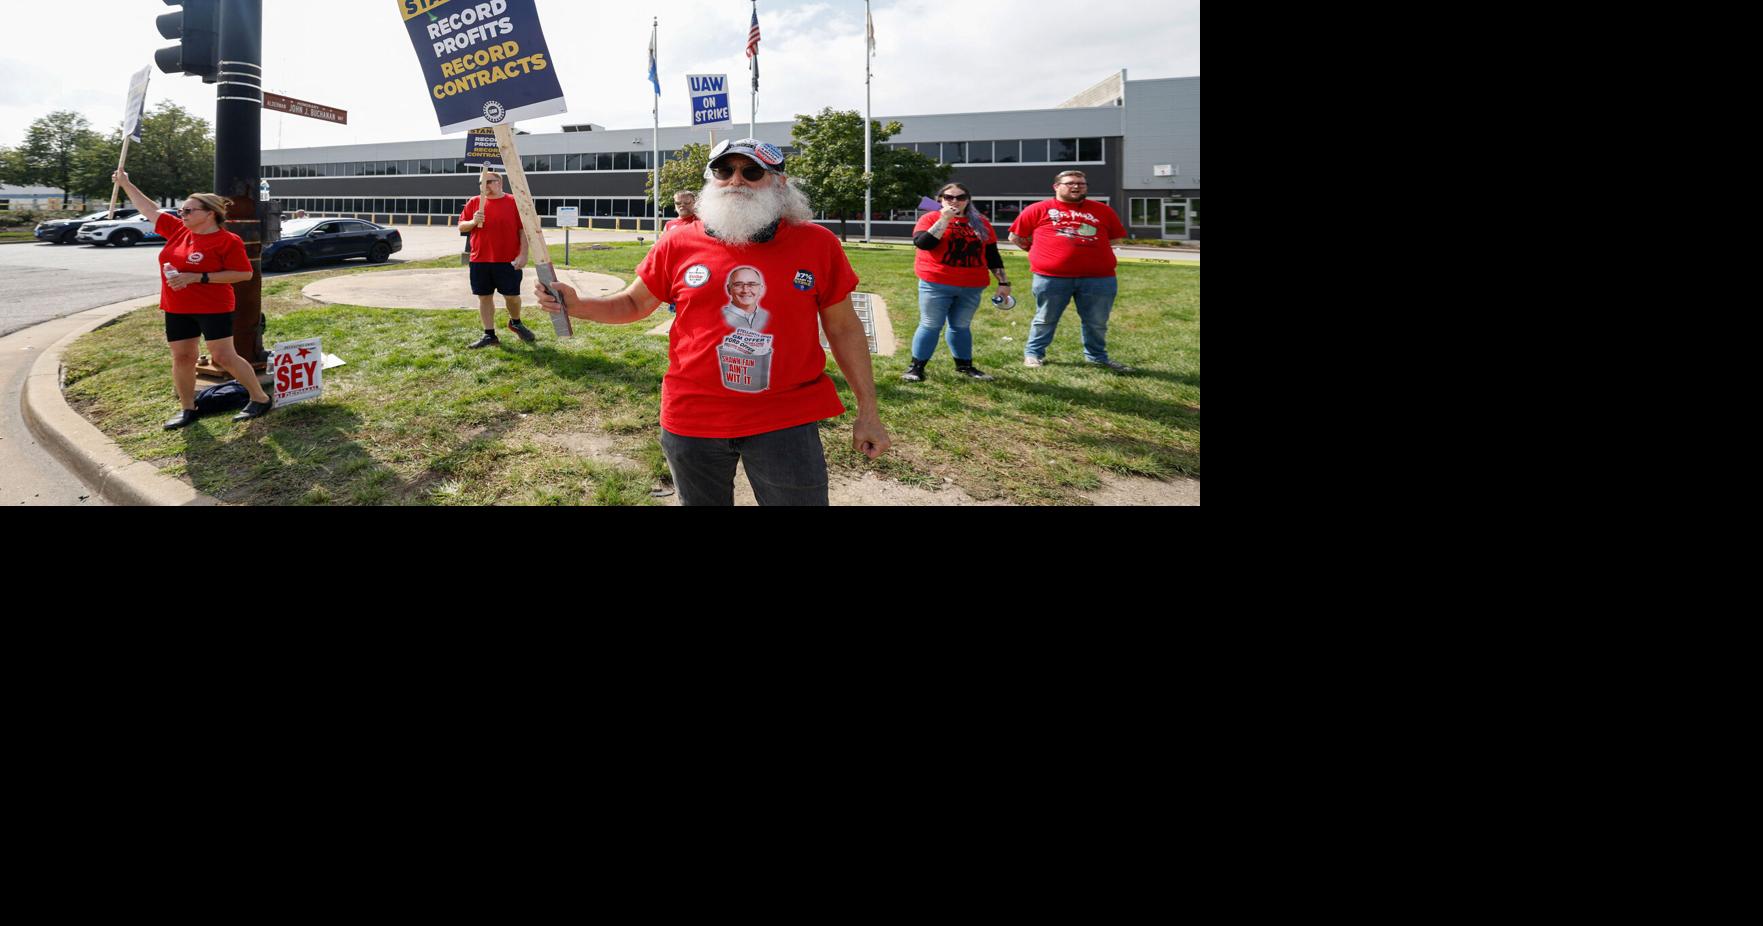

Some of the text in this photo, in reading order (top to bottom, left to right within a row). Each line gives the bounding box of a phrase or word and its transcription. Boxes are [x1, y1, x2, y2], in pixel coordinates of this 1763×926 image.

[427, 0, 507, 40] RECORD
[433, 17, 514, 58] PROFITS
[441, 41, 519, 78] RECORD
[433, 53, 547, 100] CONTRACTS
[691, 77, 723, 91] UAW
[702, 97, 716, 108] ON
[289, 104, 303, 114] JOHN
[311, 109, 336, 120] BUCHANAN
[695, 107, 729, 122] STRIKE
[725, 337, 740, 345] FORD
[740, 342, 756, 352] OFFER
[722, 355, 756, 367] SHAWN FAIN
[276, 361, 317, 392] SEY
[729, 363, 748, 375] AIN'T
[726, 372, 752, 385] WIT IT
